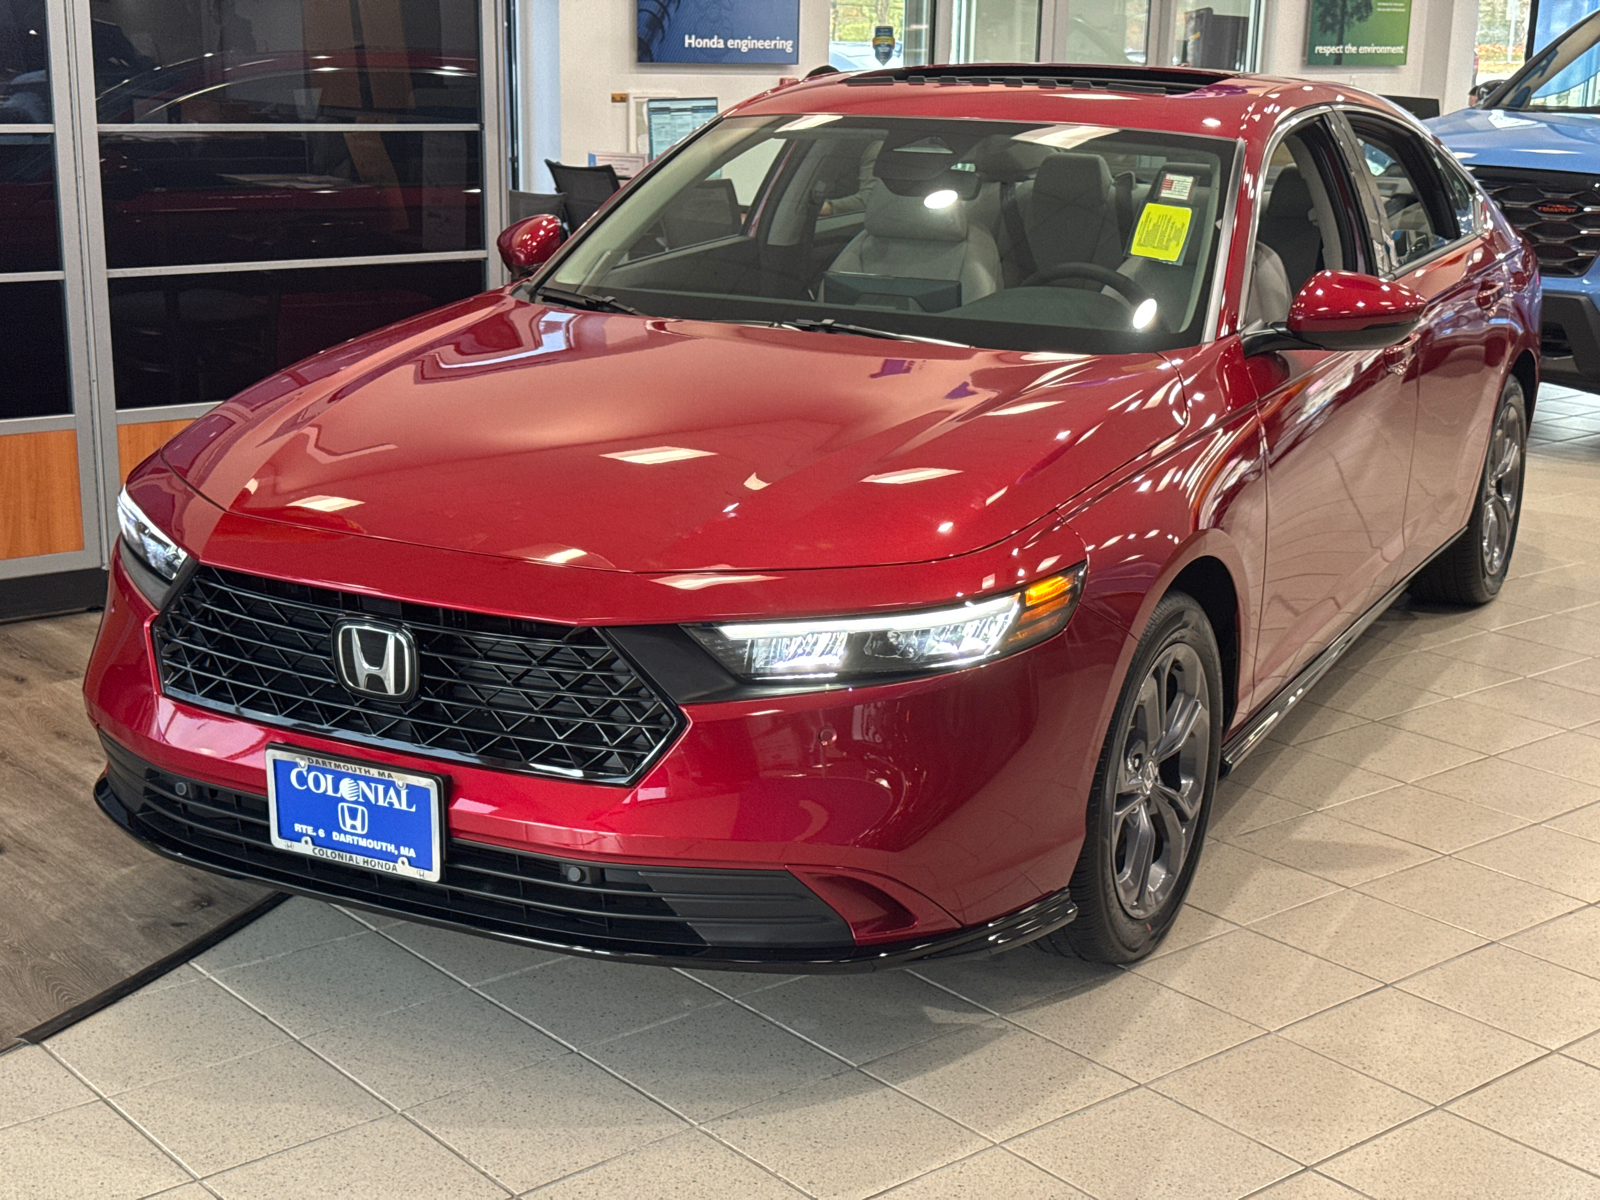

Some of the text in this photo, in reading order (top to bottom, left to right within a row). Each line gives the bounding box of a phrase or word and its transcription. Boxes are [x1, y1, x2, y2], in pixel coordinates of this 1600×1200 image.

[684, 34, 794, 53] Honda engineering
[1314, 43, 1405, 57] respect the environment
[377, 770, 394, 780] MA
[290, 767, 417, 812] COLONIAL
[294, 823, 417, 858] RTE. 6 DARTMOUTH, MA
[311, 847, 398, 872] COLONIAL HONDA
